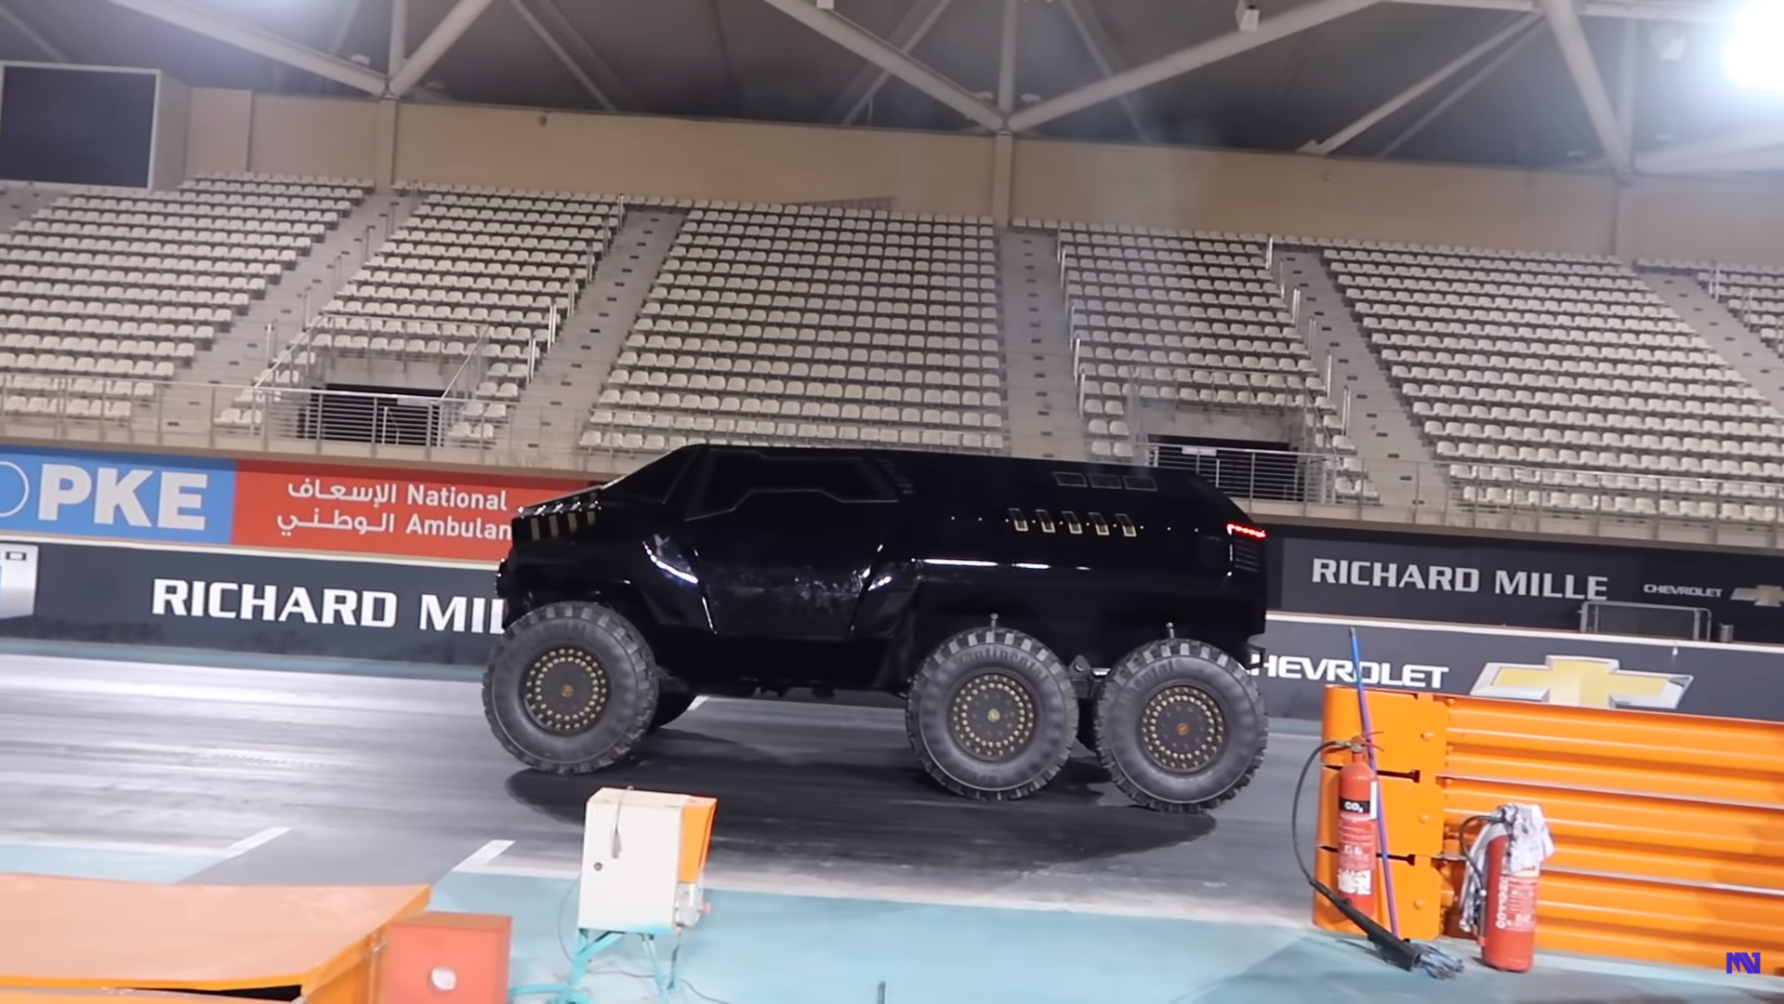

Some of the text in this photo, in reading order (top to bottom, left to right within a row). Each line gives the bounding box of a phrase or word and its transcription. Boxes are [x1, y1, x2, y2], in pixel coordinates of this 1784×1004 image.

[38, 464, 208, 531] PKE
[287, 478, 397, 508] الإسعاف
[407, 484, 507, 511] National
[277, 508, 394, 537] الوطني
[406, 514, 512, 541] Ambulan
[1312, 558, 1608, 601] RICHARD MILLE
[1643, 584, 1723, 598] CHEVROLET
[152, 578, 505, 634] RICHARD MIL
[1245, 654, 1449, 689] HEVROLET
